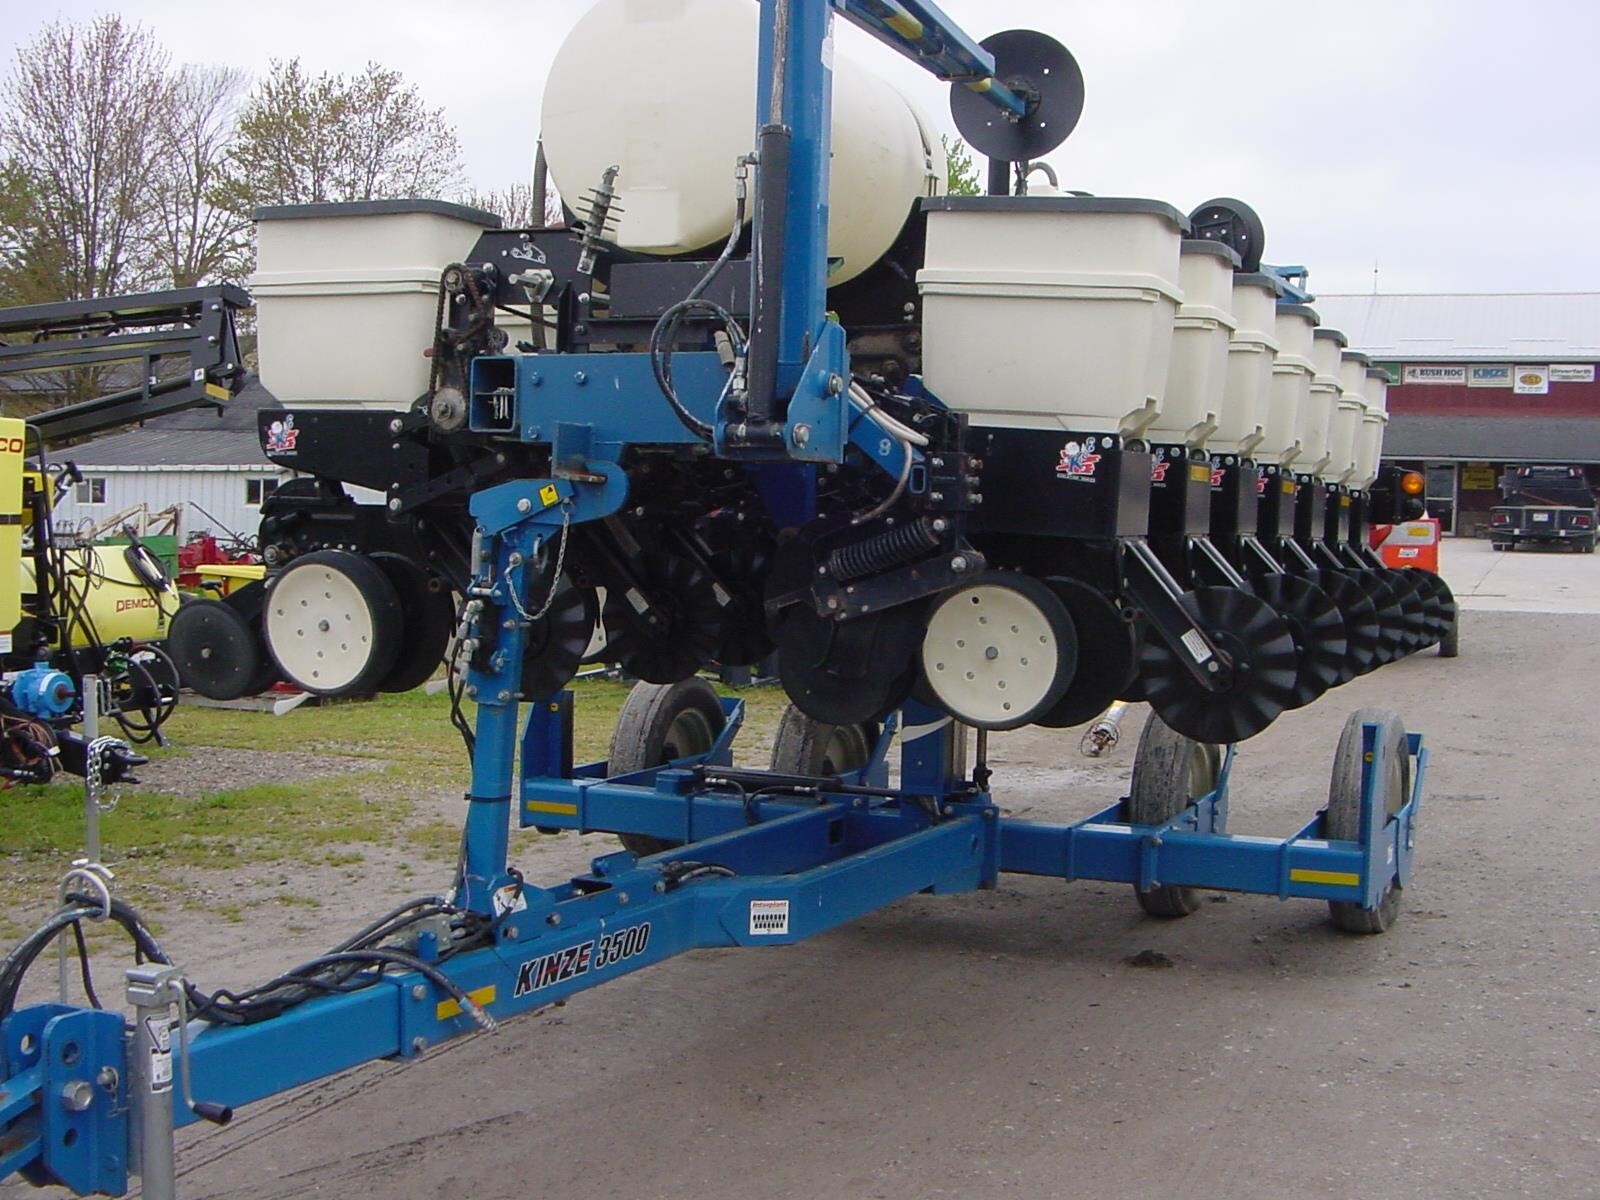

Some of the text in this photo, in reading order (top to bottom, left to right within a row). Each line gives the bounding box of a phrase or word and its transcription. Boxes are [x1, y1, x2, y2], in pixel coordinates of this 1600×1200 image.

[1443, 368, 1463, 377] HOG
[1472, 367, 1509, 379] KINZE
[0, 437, 23, 453] CO
[115, 598, 157, 613] DEMCO
[513, 922, 651, 998] KINZE 3500
